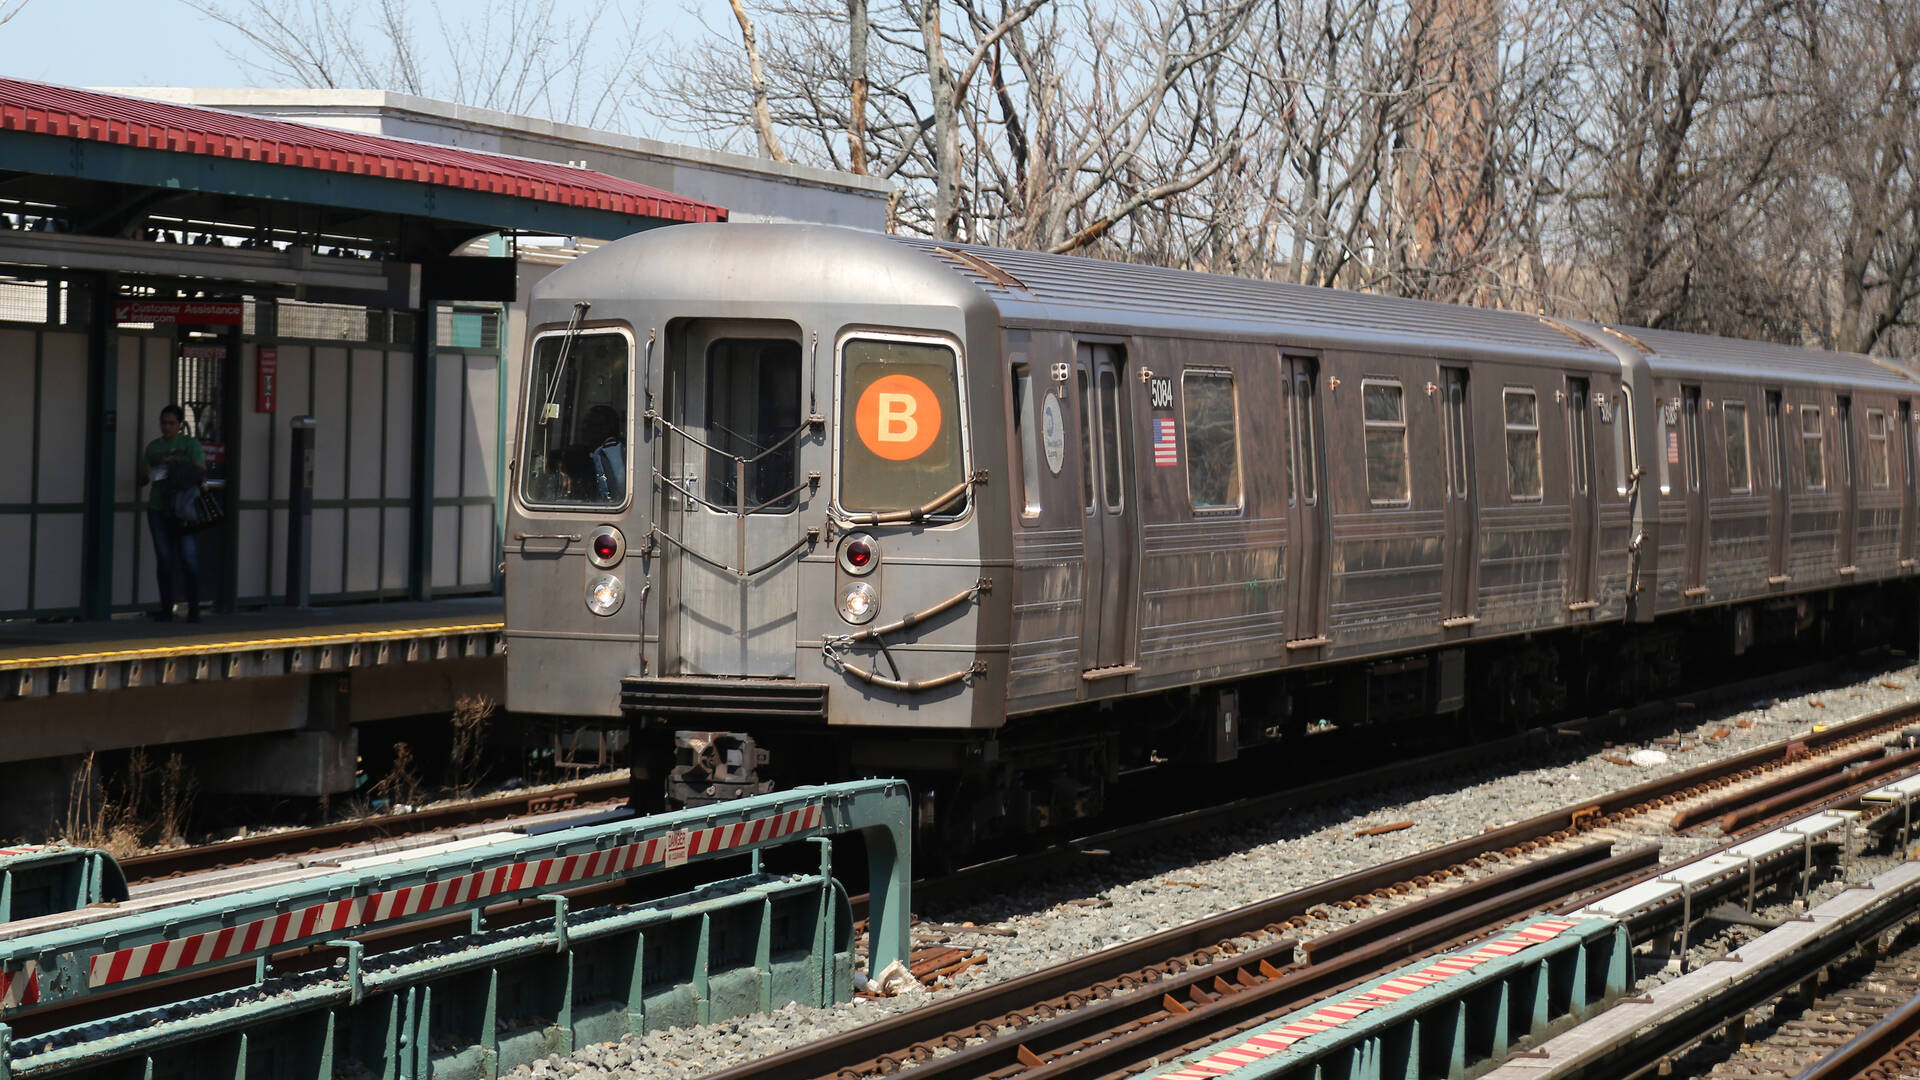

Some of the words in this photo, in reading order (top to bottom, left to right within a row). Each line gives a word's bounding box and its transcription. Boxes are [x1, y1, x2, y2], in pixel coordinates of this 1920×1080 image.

[131, 303, 181, 314] Customer
[184, 305, 240, 315] Assistance
[131, 313, 176, 323] Intercom
[1151, 379, 1173, 407] 5084
[878, 393, 918, 442] B
